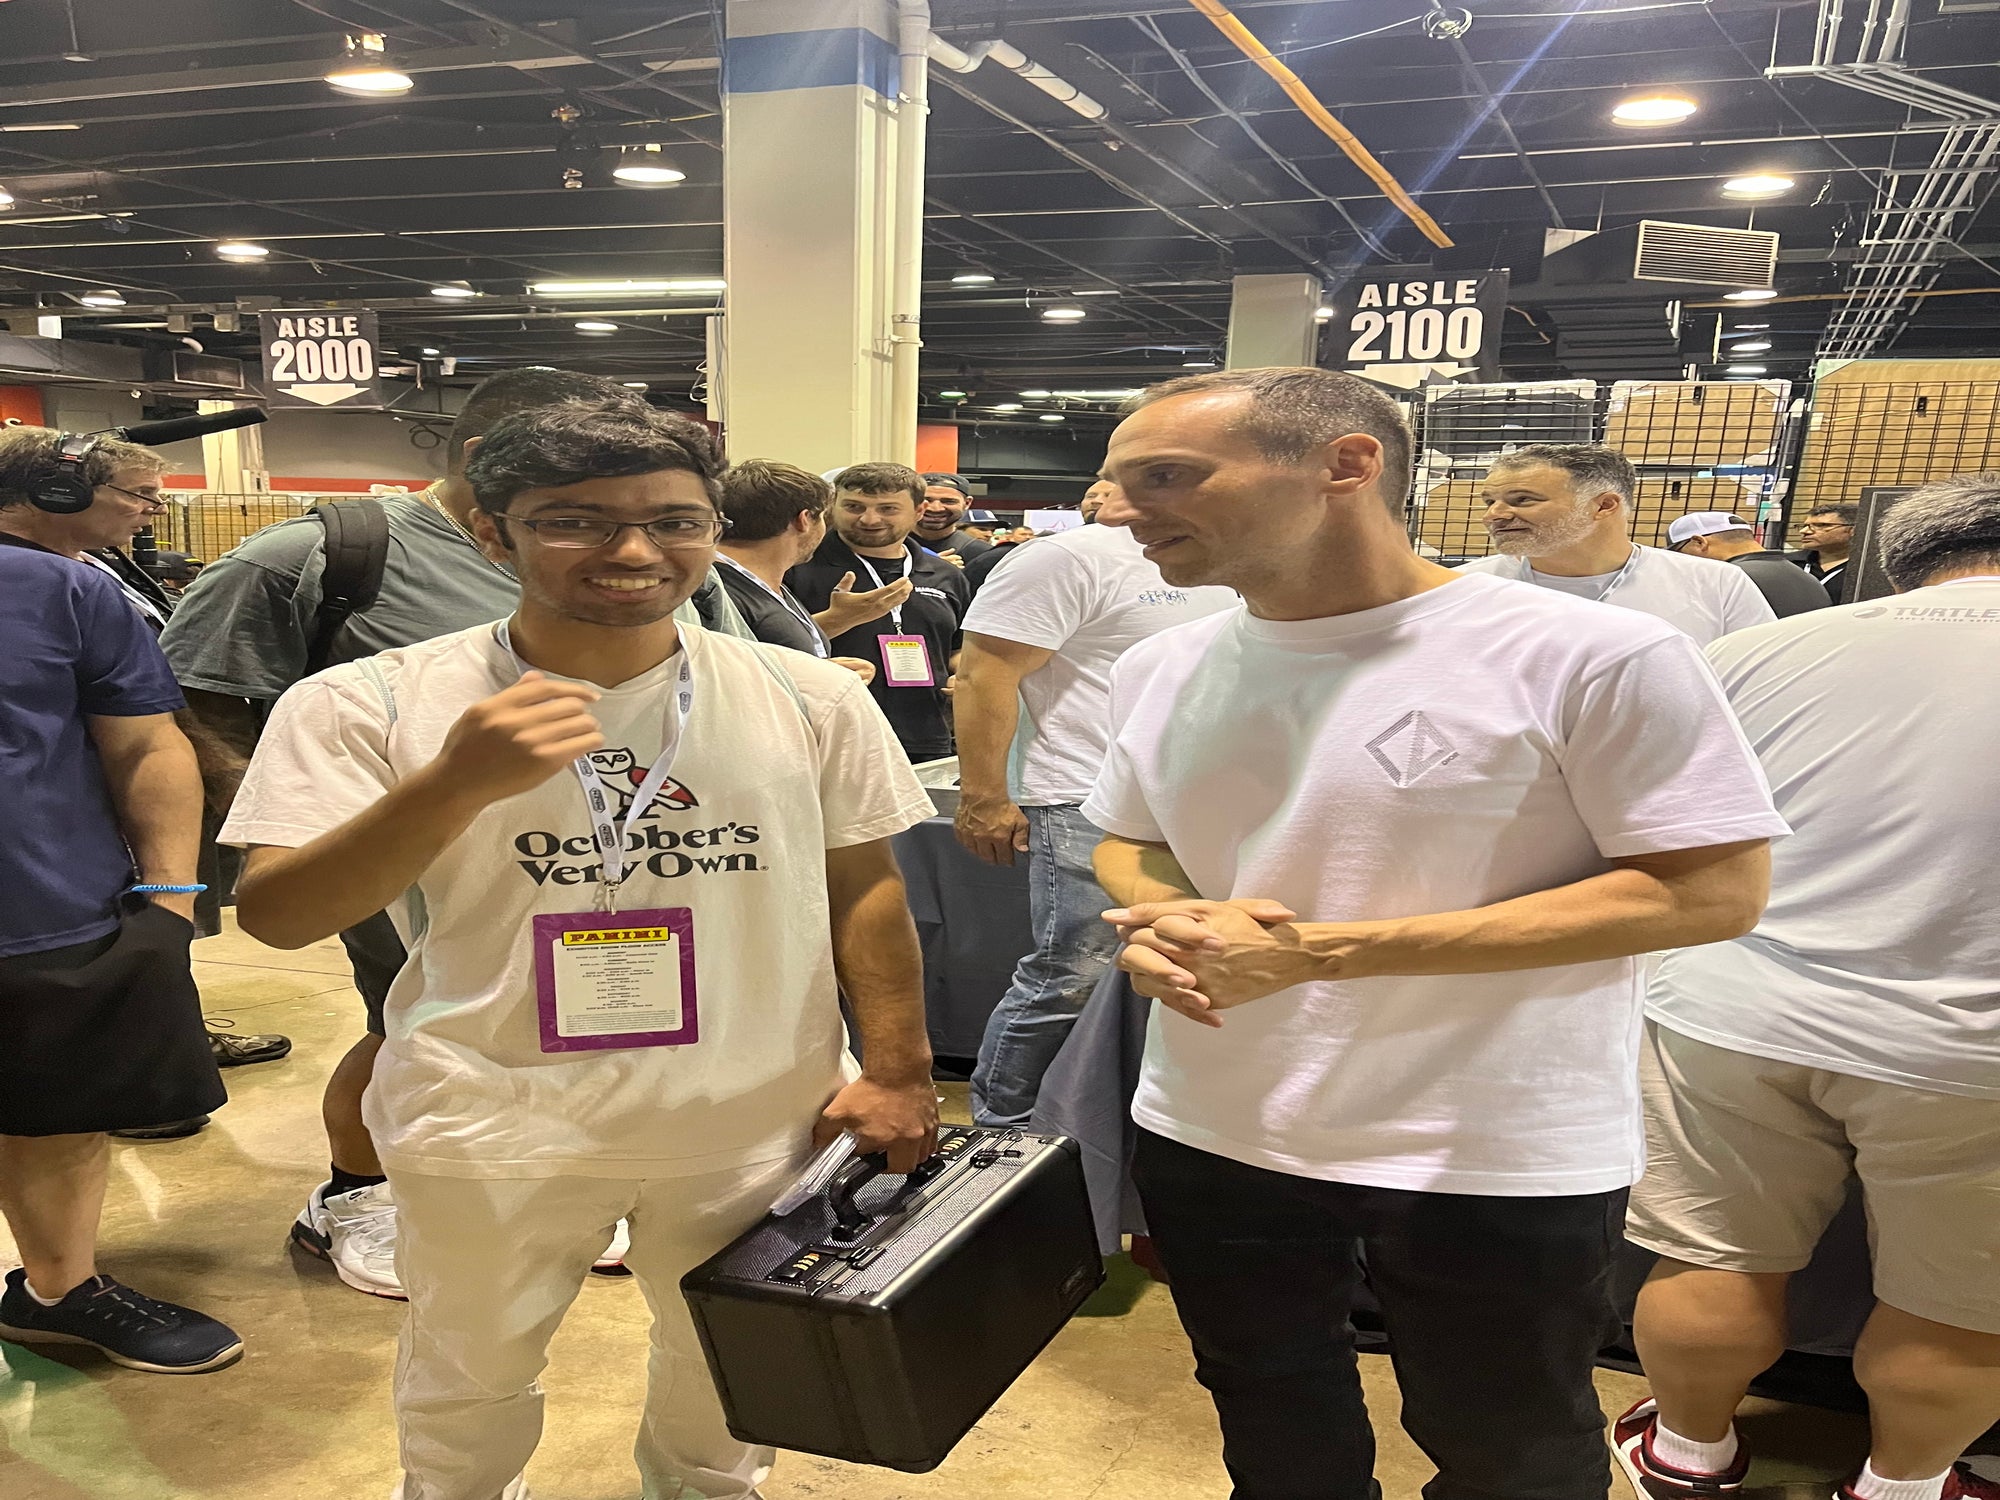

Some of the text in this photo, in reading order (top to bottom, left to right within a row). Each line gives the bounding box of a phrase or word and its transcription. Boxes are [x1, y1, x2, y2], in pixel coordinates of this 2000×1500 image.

[1357, 279, 1478, 308] AISLE
[278, 317, 359, 338] AISLE
[1348, 307, 1484, 362] 2100
[270, 338, 373, 382] 2000
[1896, 607, 2000, 618] TURTLE
[518, 858, 642, 887] Very
[570, 930, 662, 942] PANINI
